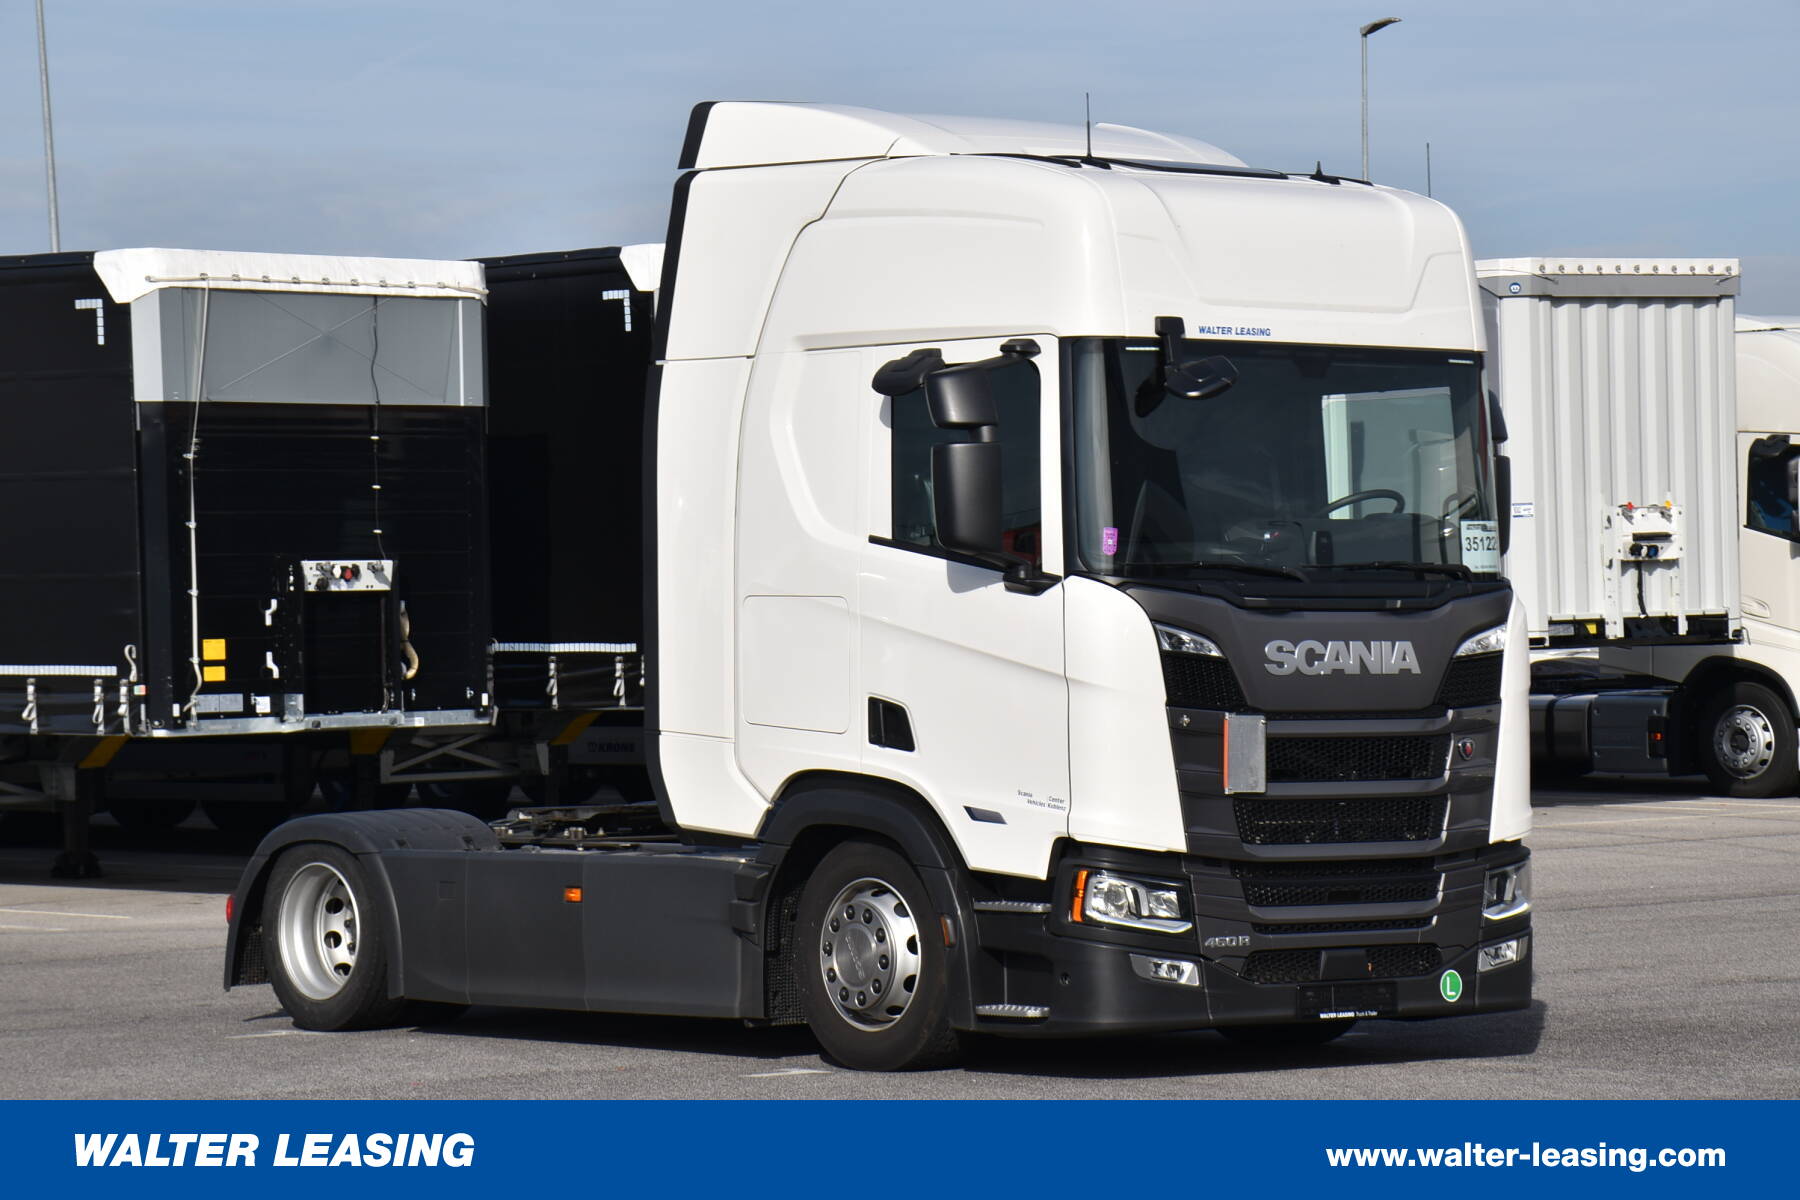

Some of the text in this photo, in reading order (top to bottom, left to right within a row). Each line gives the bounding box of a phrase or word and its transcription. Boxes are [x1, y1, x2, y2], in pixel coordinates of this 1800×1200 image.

[1198, 326, 1271, 337] WALTER LEASING
[1465, 536, 1497, 552] 35122
[1264, 640, 1421, 676] SCANIA
